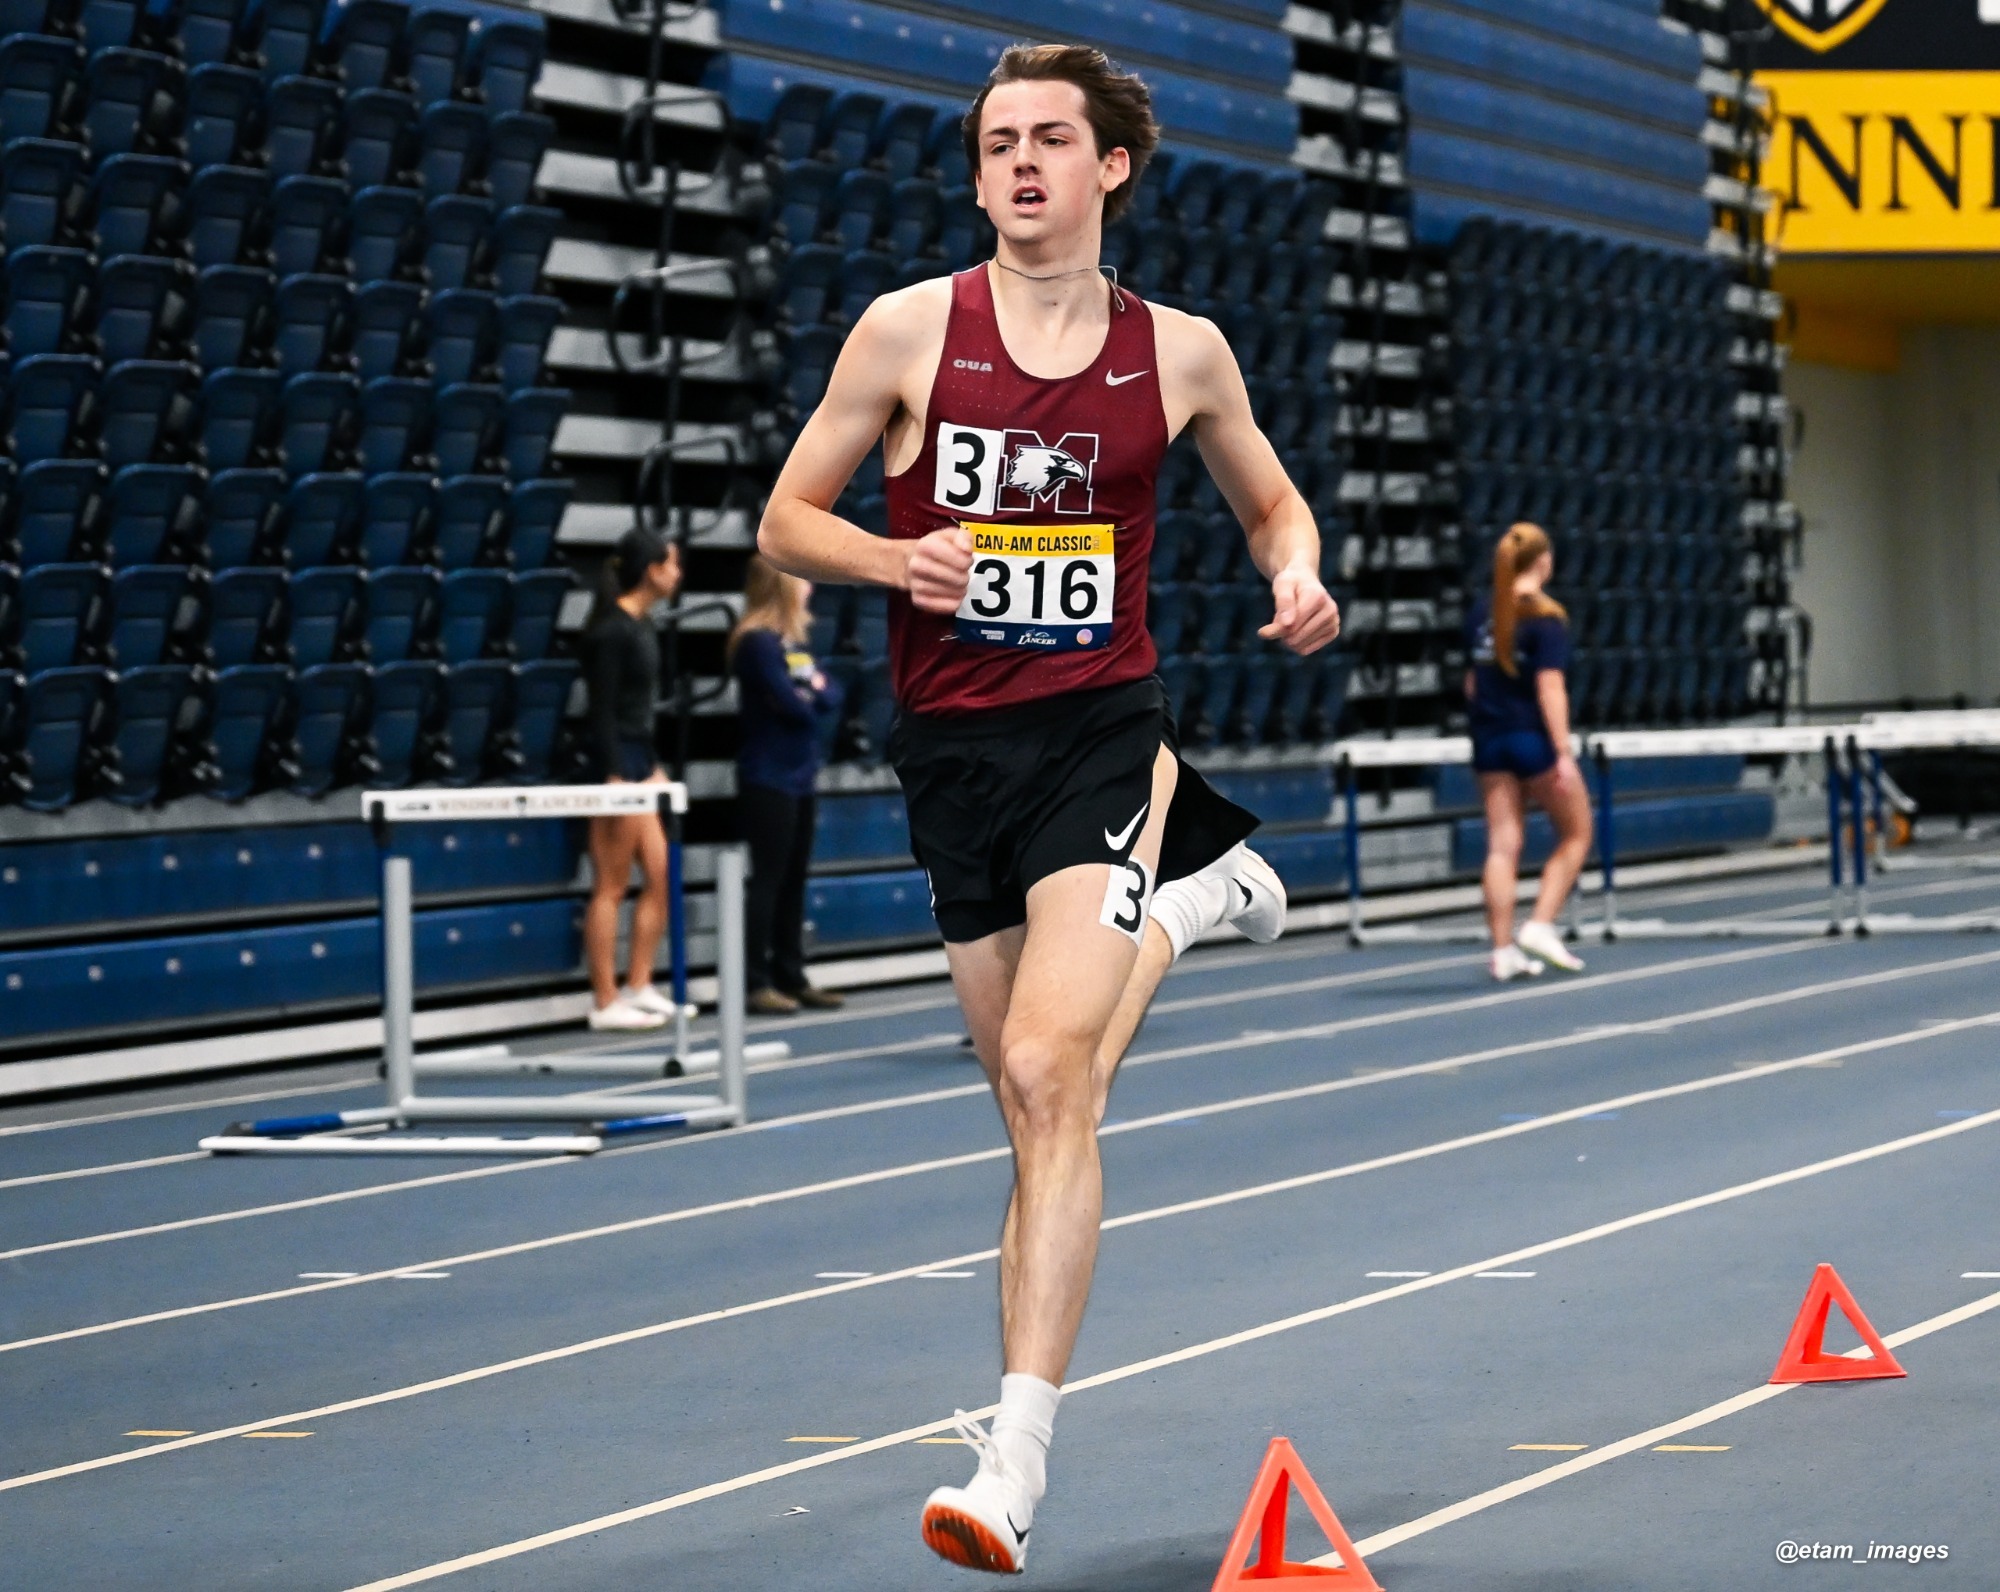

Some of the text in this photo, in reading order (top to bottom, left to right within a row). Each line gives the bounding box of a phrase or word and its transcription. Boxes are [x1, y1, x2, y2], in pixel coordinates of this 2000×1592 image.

[953, 358, 993, 372] OUA
[946, 431, 986, 507] 3
[997, 428, 1099, 514] M
[975, 533, 1092, 552] CAN-AM CLASSIC
[970, 558, 1099, 620] 316
[1017, 634, 1057, 645] LANCERS
[1113, 860, 1146, 933] 3
